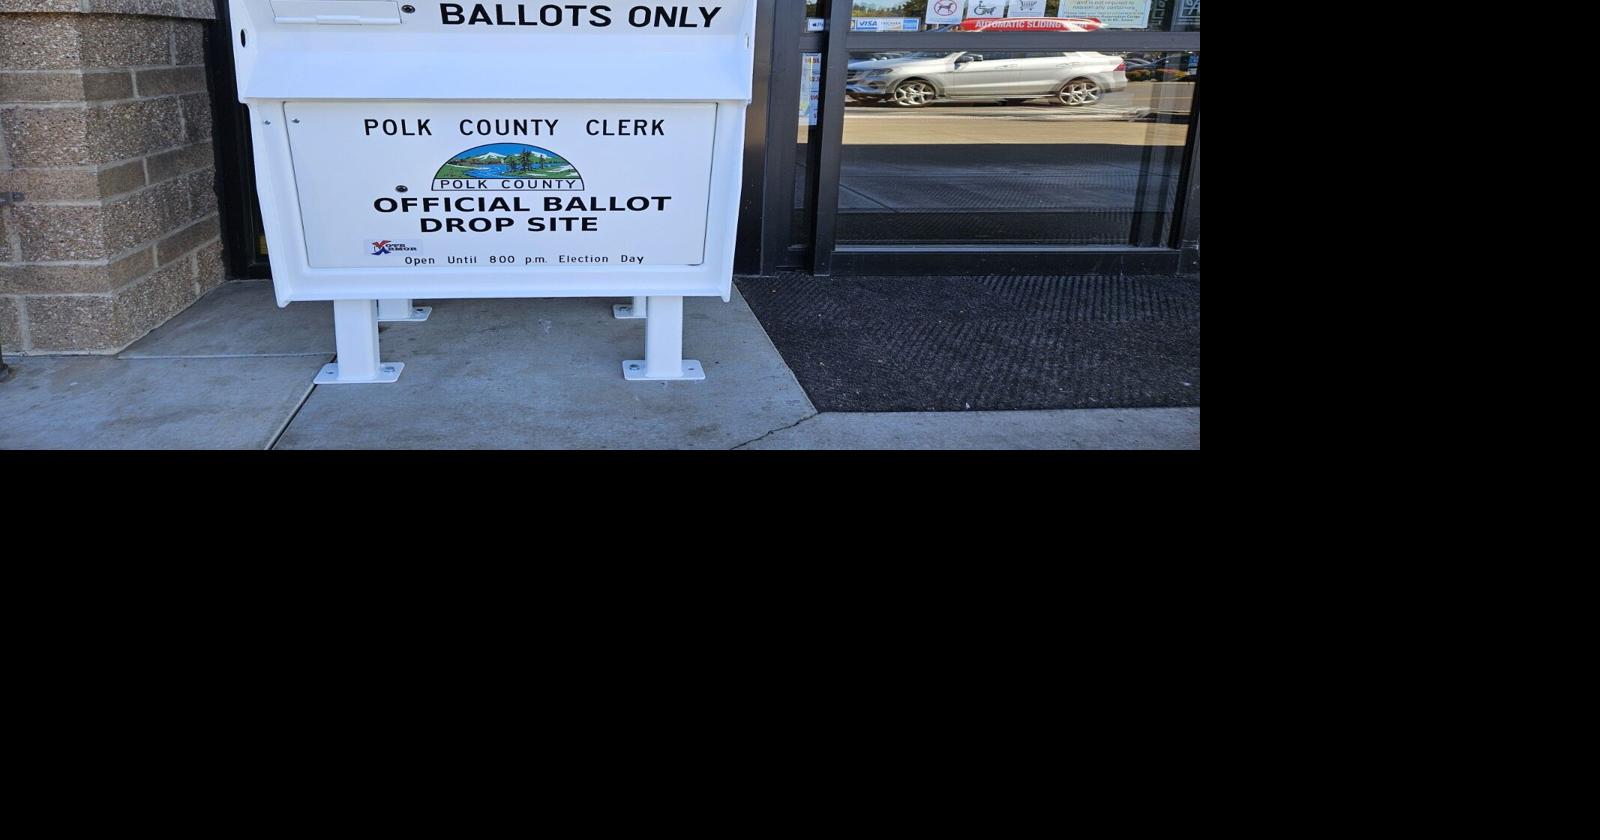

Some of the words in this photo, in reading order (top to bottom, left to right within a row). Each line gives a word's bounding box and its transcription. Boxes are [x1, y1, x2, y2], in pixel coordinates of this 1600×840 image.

[439, 3, 612, 27] BALLOTS
[628, 5, 722, 28] ONLY
[975, 20, 1025, 29] AUTOMATIC
[1026, 20, 1062, 29] SLIDING
[365, 119, 433, 136] POLK
[459, 119, 559, 136] COUNTY
[586, 119, 665, 136] CLERK
[440, 179, 488, 190] POLK
[501, 179, 577, 190] COUNTY
[373, 196, 531, 213] OFFICIAL
[543, 196, 672, 212] BALLOT
[420, 217, 515, 233] DROP
[527, 216, 598, 232] SITE
[404, 256, 435, 266] Open
[447, 255, 477, 265] Until
[558, 254, 609, 264] Election
[620, 254, 644, 265] Day
